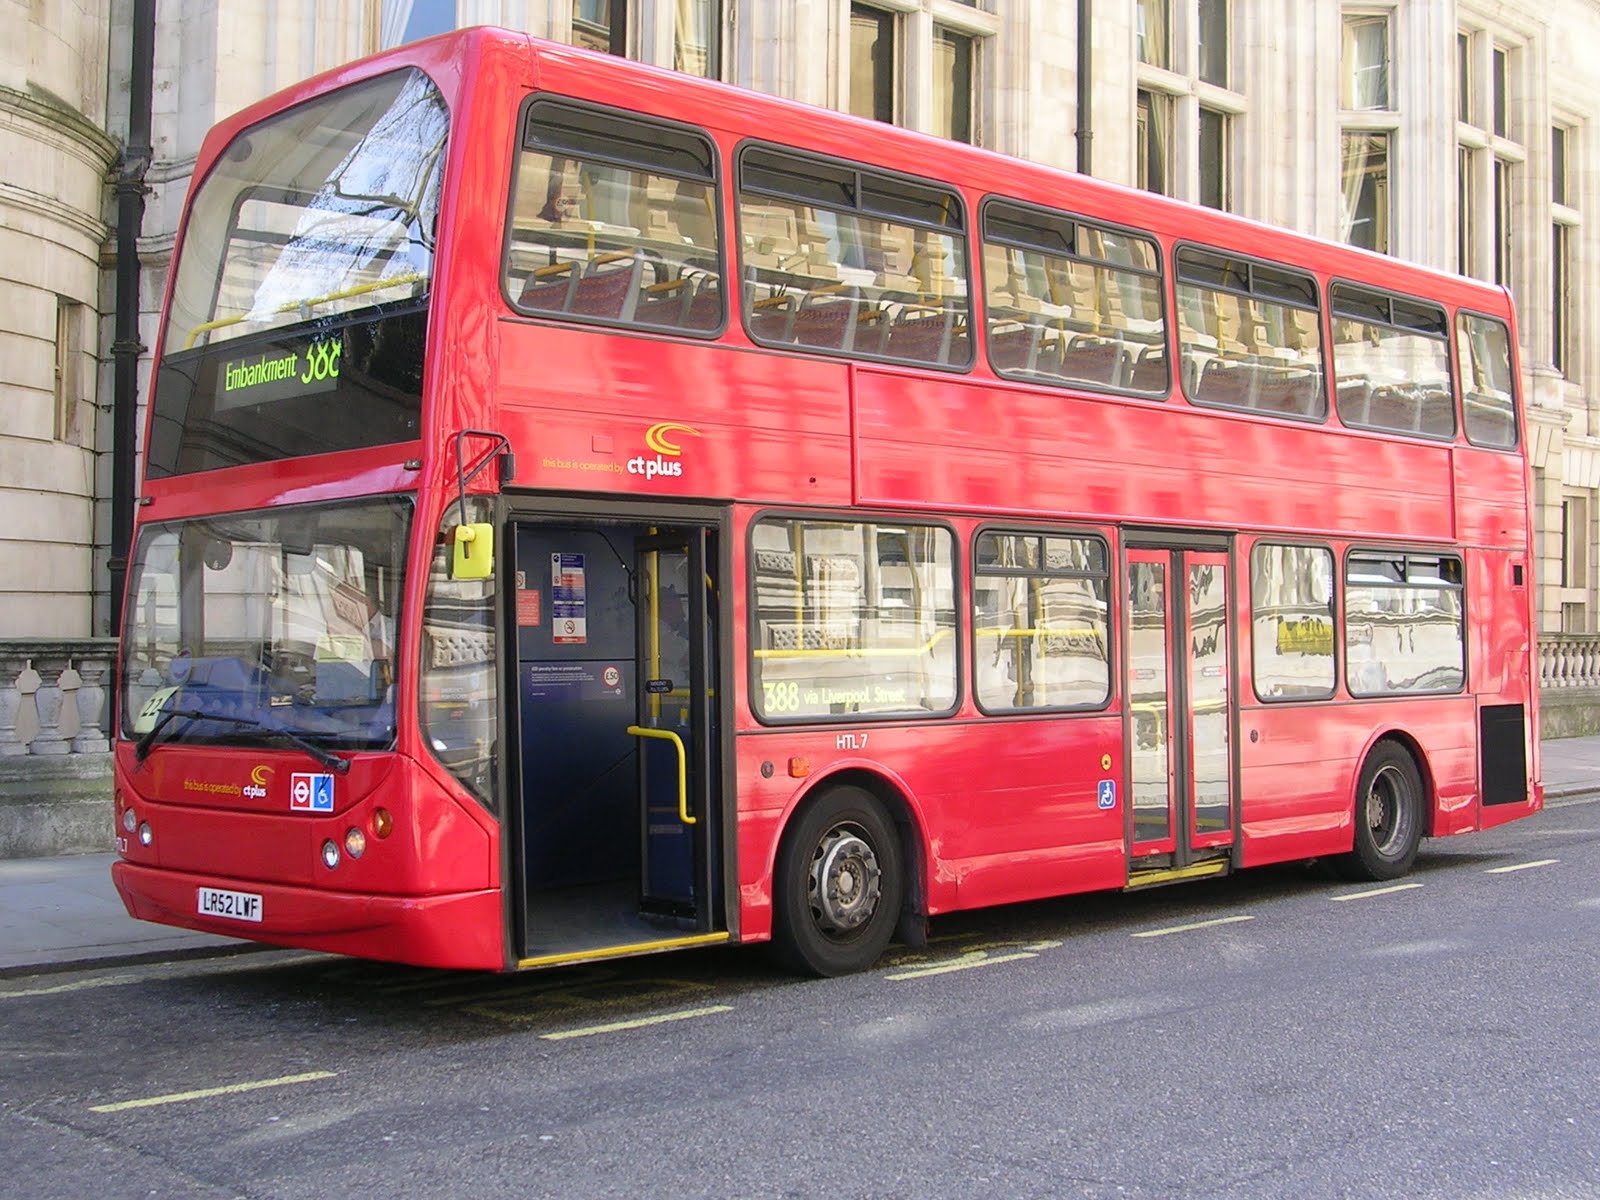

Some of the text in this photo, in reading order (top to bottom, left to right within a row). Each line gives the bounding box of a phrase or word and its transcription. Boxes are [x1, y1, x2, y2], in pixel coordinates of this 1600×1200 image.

[225, 353, 298, 391] Embankment
[762, 681, 906, 712] 388 via Liverpool Street
[836, 733, 868, 750] HTL 7
[203, 891, 259, 918] LR52 LWF
